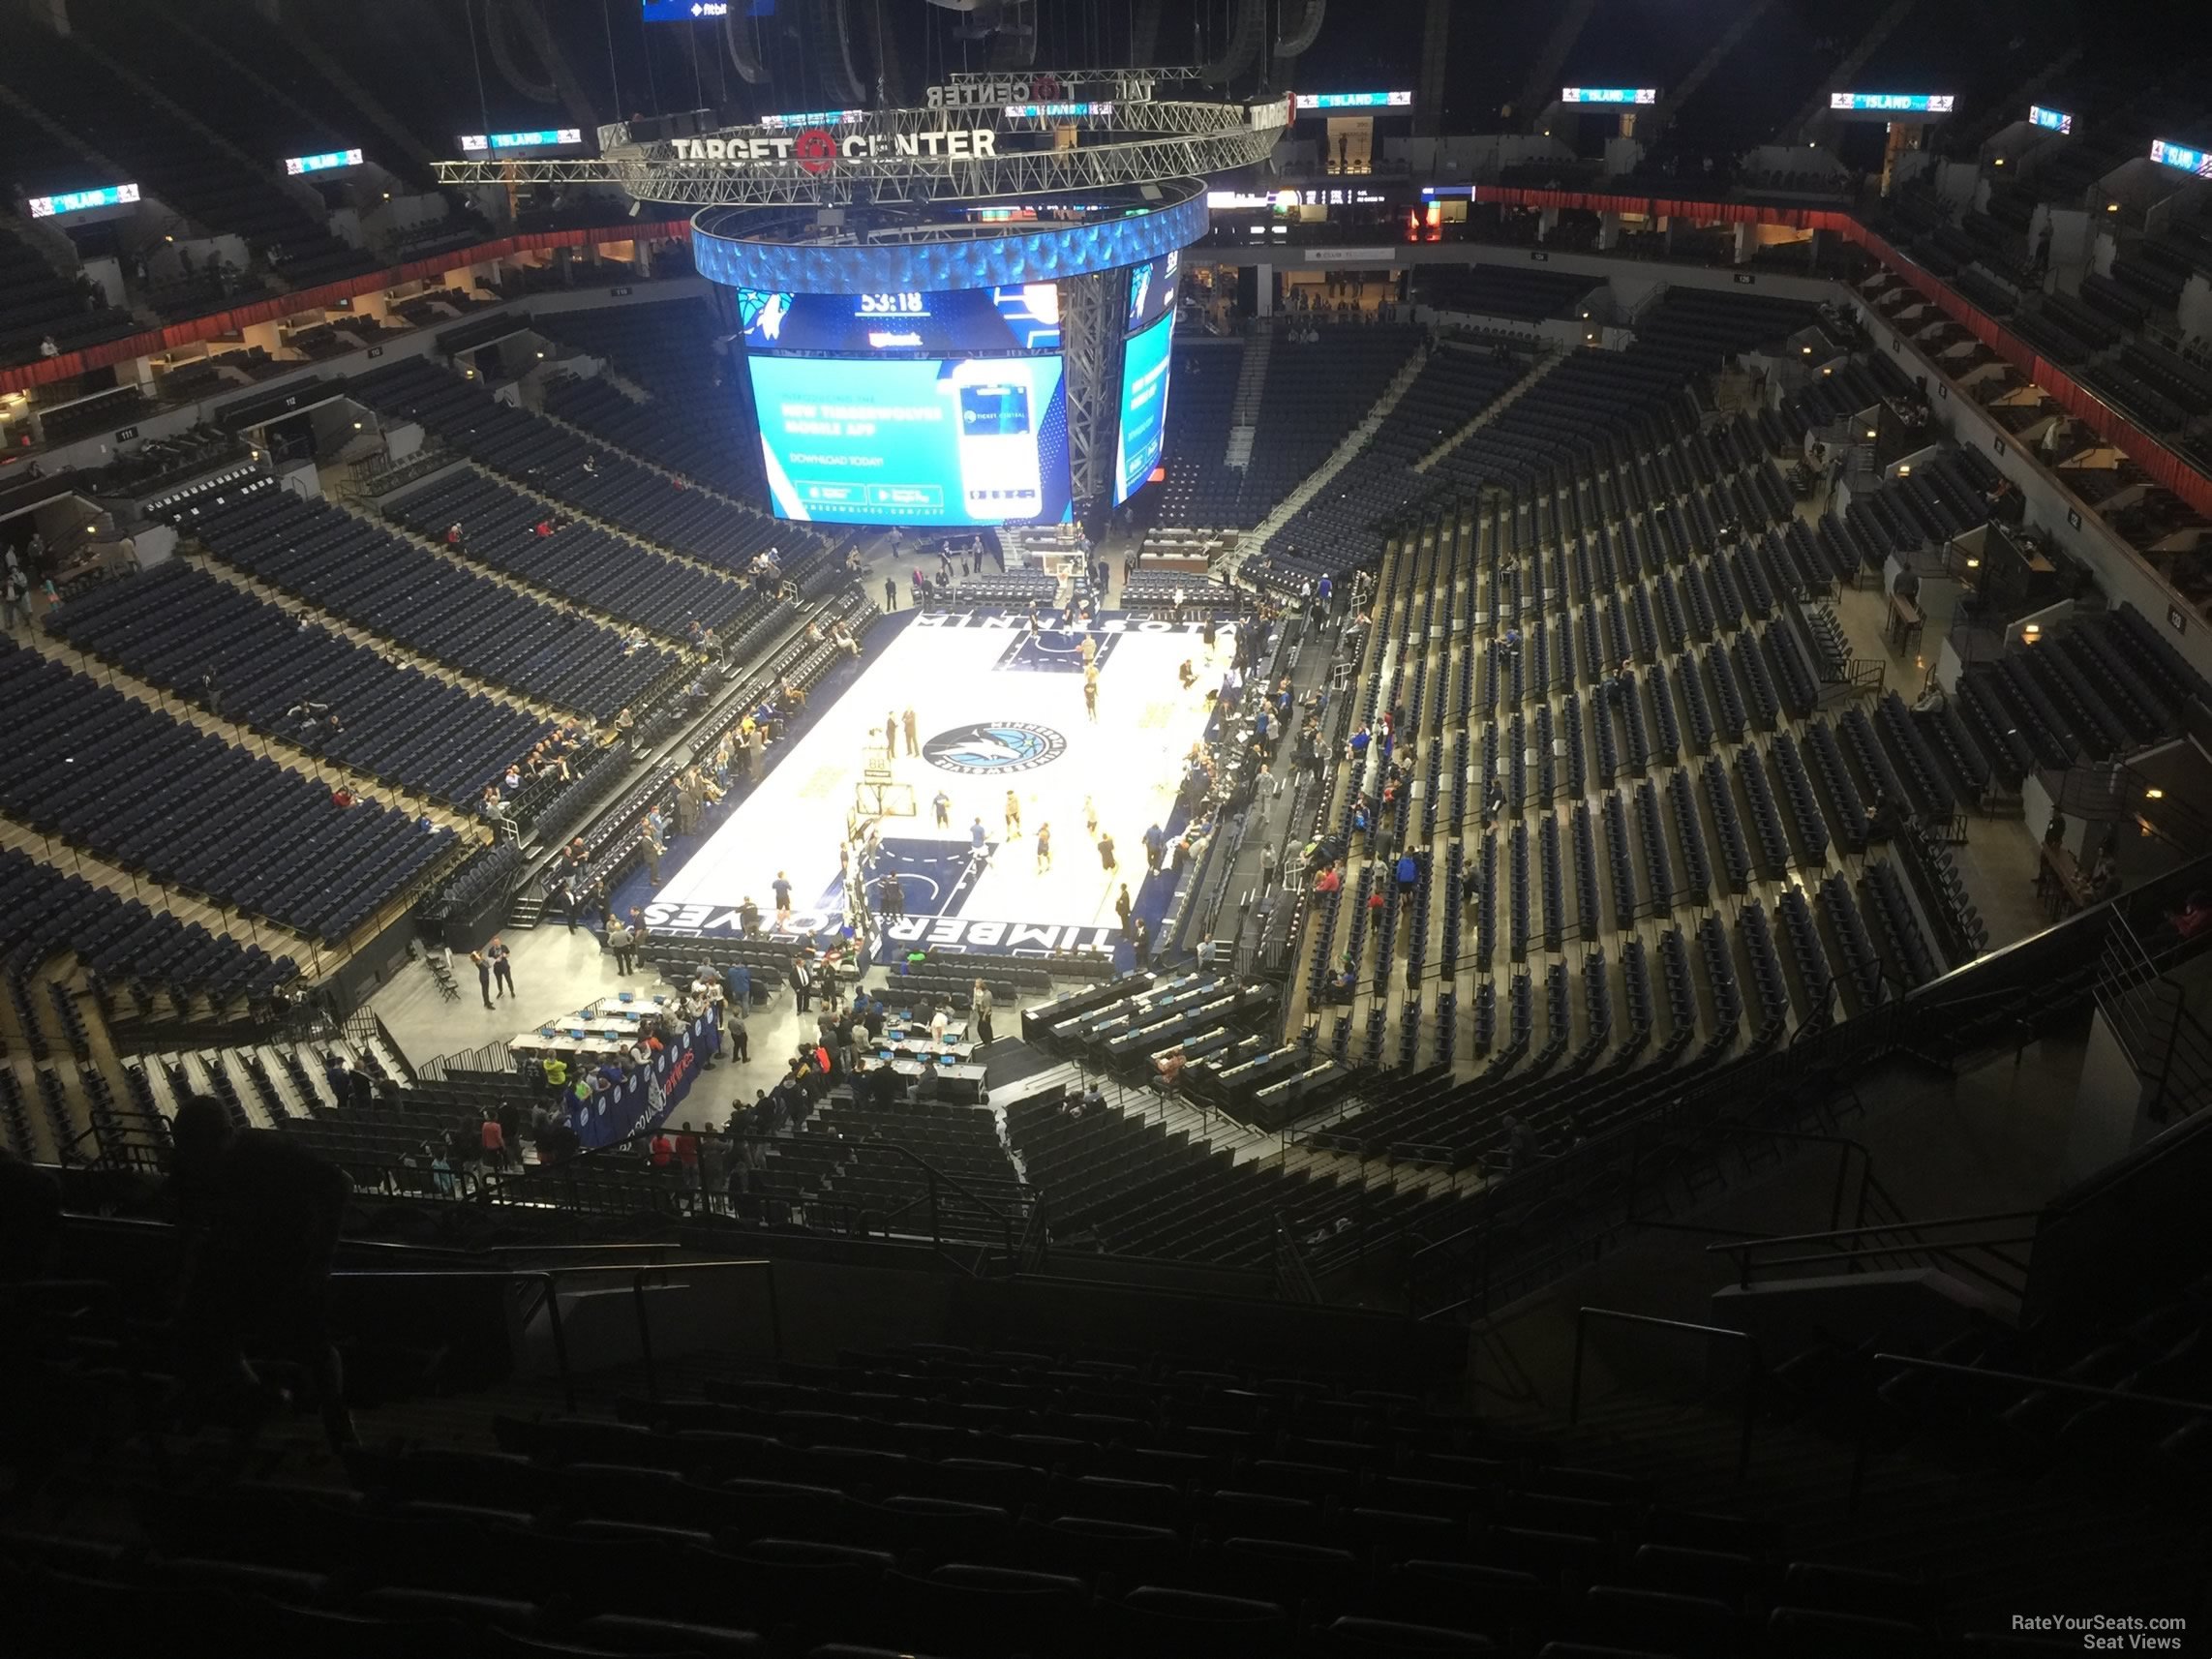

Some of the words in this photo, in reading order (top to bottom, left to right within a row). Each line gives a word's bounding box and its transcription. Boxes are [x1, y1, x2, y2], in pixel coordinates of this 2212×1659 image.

[1330, 94, 1373, 106] ISLAND
[1589, 89, 1623, 102] ISLAND
[1866, 95, 1911, 108] ISLAND
[498, 133, 542, 147] ISLAND
[672, 137, 793, 166] TARGET
[842, 129, 996, 164] CENTER
[861, 292, 923, 312] 53:18
[121, 429, 133, 440] 111
[847, 423, 875, 436] APP
[790, 453, 847, 466] DOWNLOAD
[848, 456, 884, 468] TODAY!
[909, 616, 1238, 635] MINNESOTA
[990, 721, 1065, 749] MINNESOTA
[933, 748, 1062, 775] TIMBERWOLVES
[666, 1048, 694, 1096] airlines
